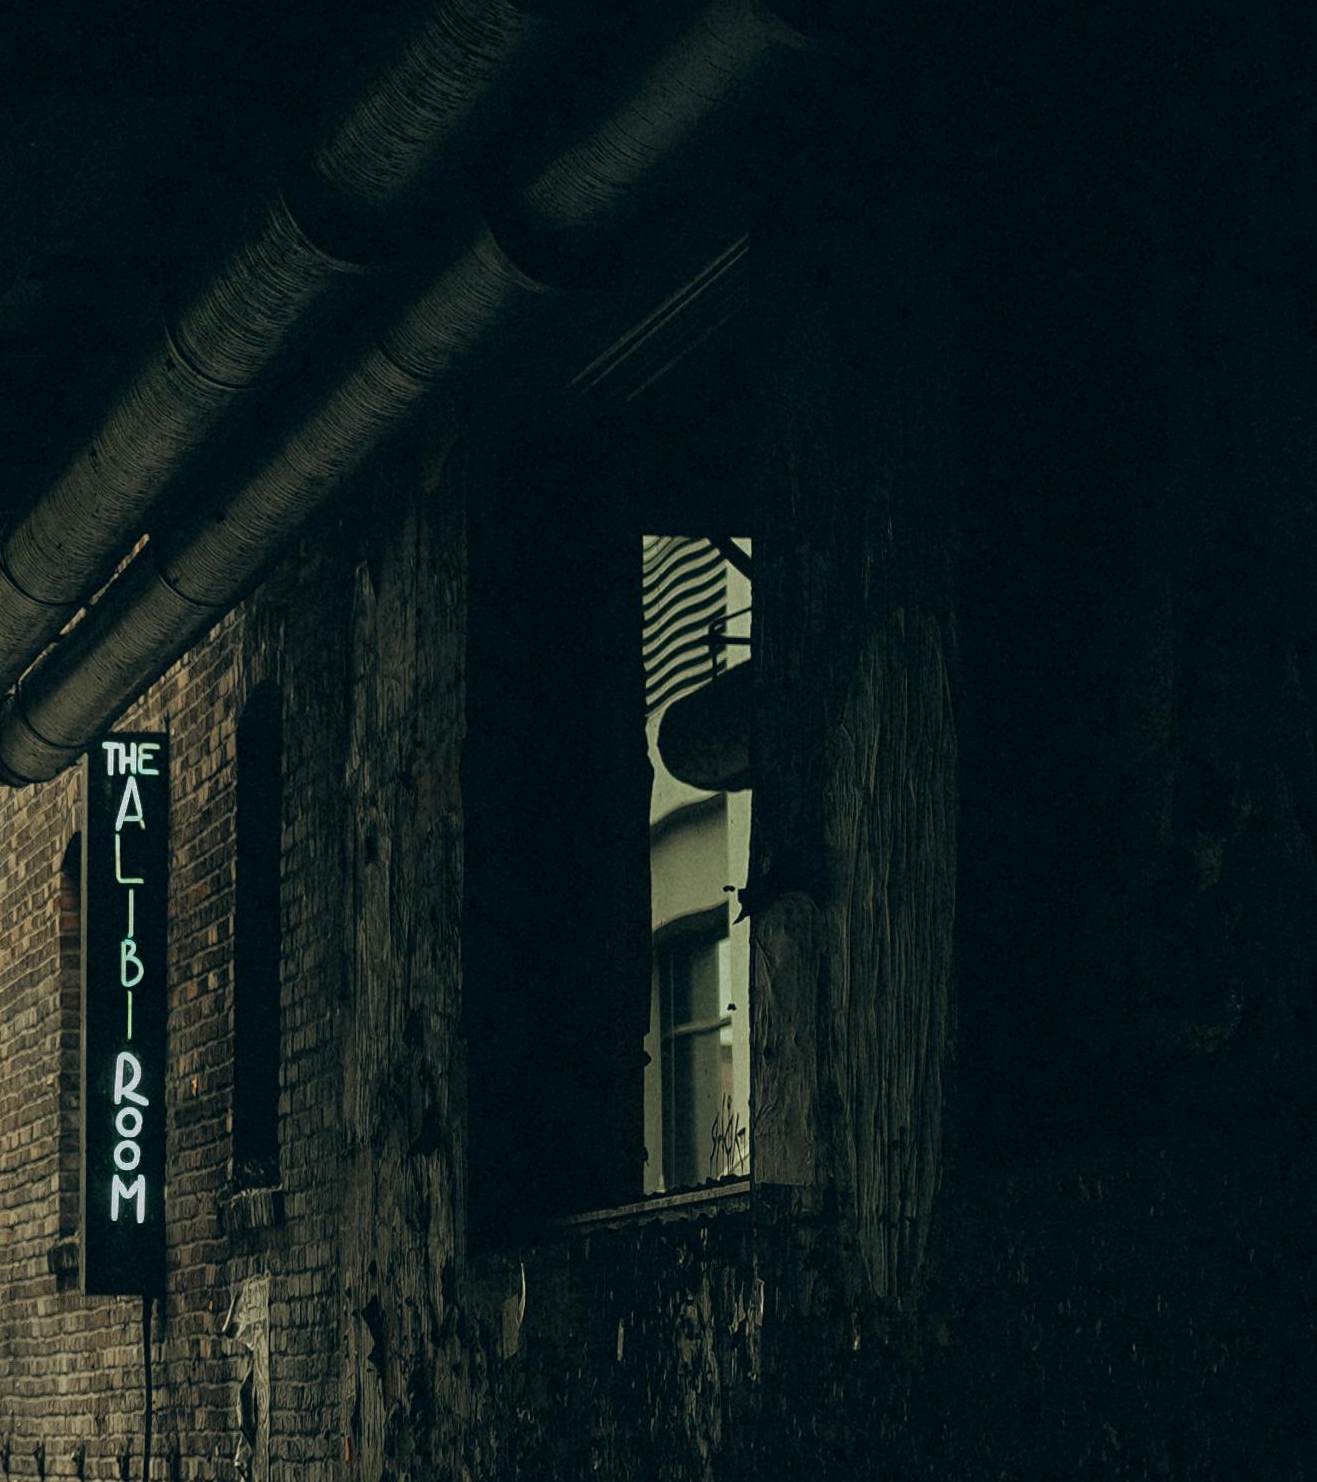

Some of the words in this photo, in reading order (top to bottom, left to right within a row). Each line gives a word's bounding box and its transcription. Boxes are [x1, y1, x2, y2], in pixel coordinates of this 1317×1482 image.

[101, 740, 161, 777] THE
[114, 775, 146, 1040] ALIBI
[110, 1050, 150, 1224] ROOM
